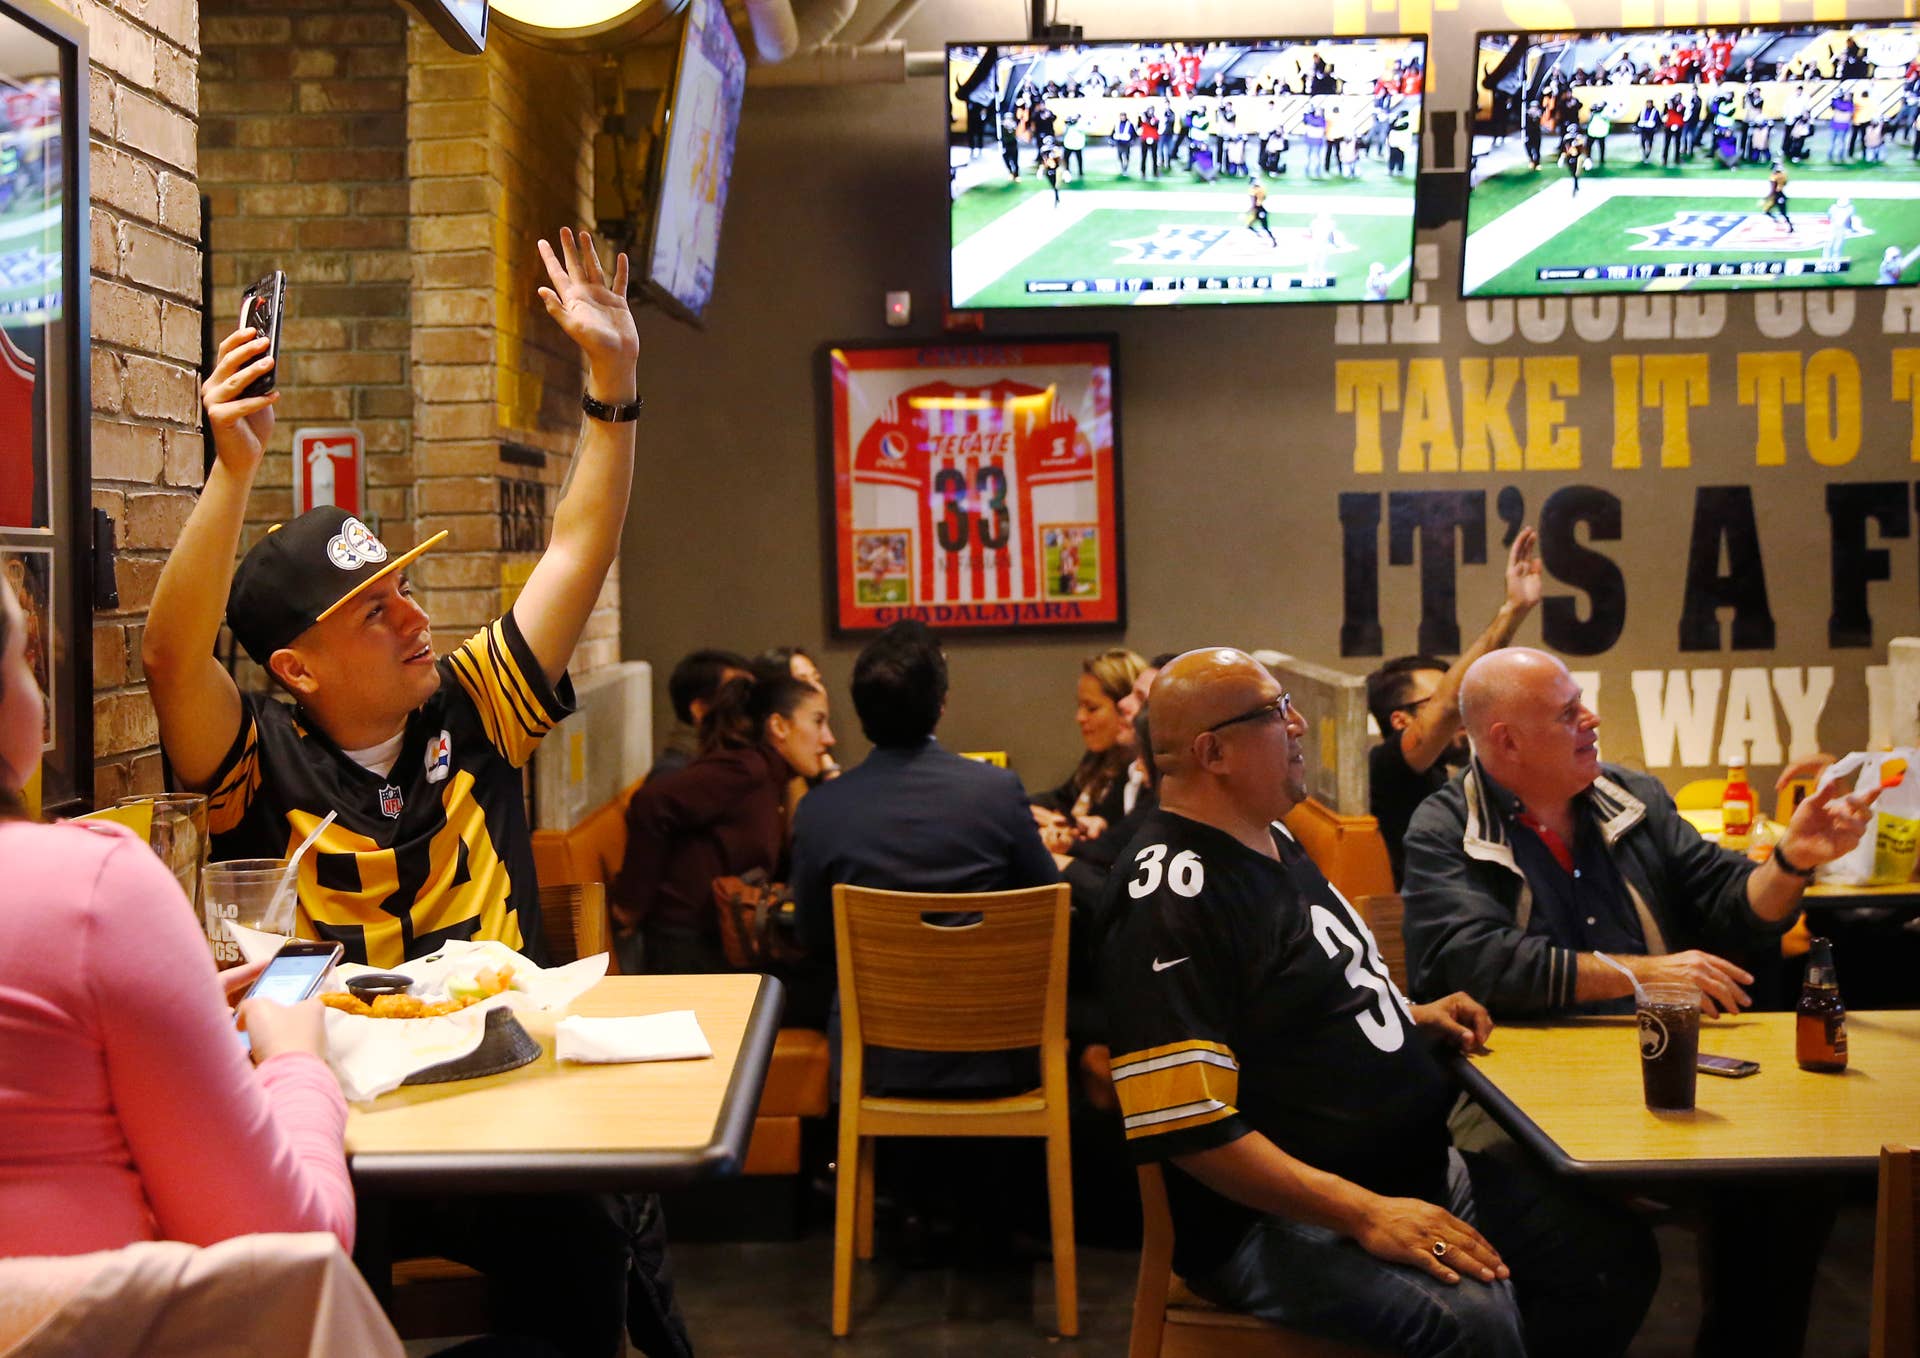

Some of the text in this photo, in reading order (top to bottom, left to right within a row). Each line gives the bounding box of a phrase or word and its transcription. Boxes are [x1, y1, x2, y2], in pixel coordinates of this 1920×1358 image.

[930, 433, 1012, 457] TECATE
[1335, 356, 1583, 474] TAKE
[1610, 352, 1710, 469] IT
[1737, 347, 1862, 467] TO
[934, 466, 1011, 553] 33
[1338, 481, 1920, 657] IT'S A F
[874, 601, 1083, 625] GUADALAJARA
[1632, 665, 1835, 767] WAY
[384, 798, 403, 816] NFL
[1127, 843, 1205, 899] 36
